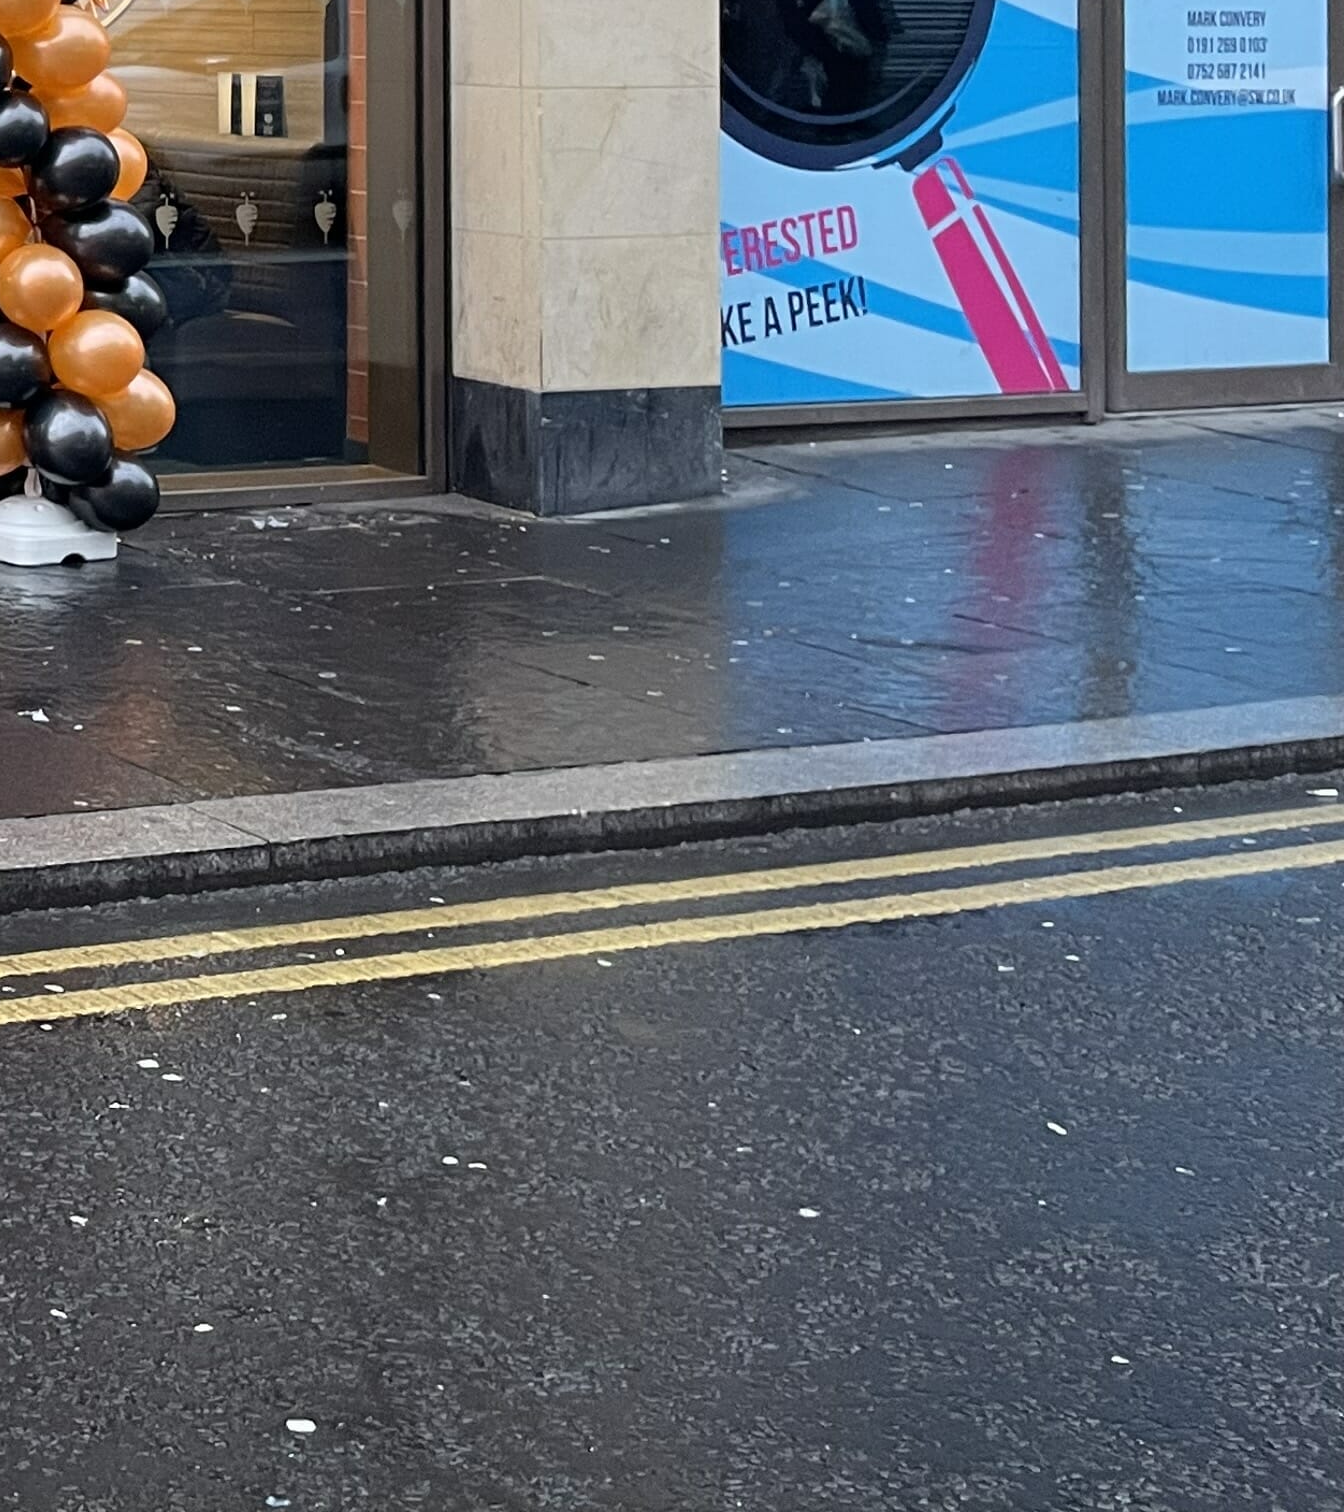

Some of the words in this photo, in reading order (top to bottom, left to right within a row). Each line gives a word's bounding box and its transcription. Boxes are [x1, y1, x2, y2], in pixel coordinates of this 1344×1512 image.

[1187, 11, 1216, 26] MARK
[764, 297, 783, 338] A
[788, 276, 869, 331] PEEK!
